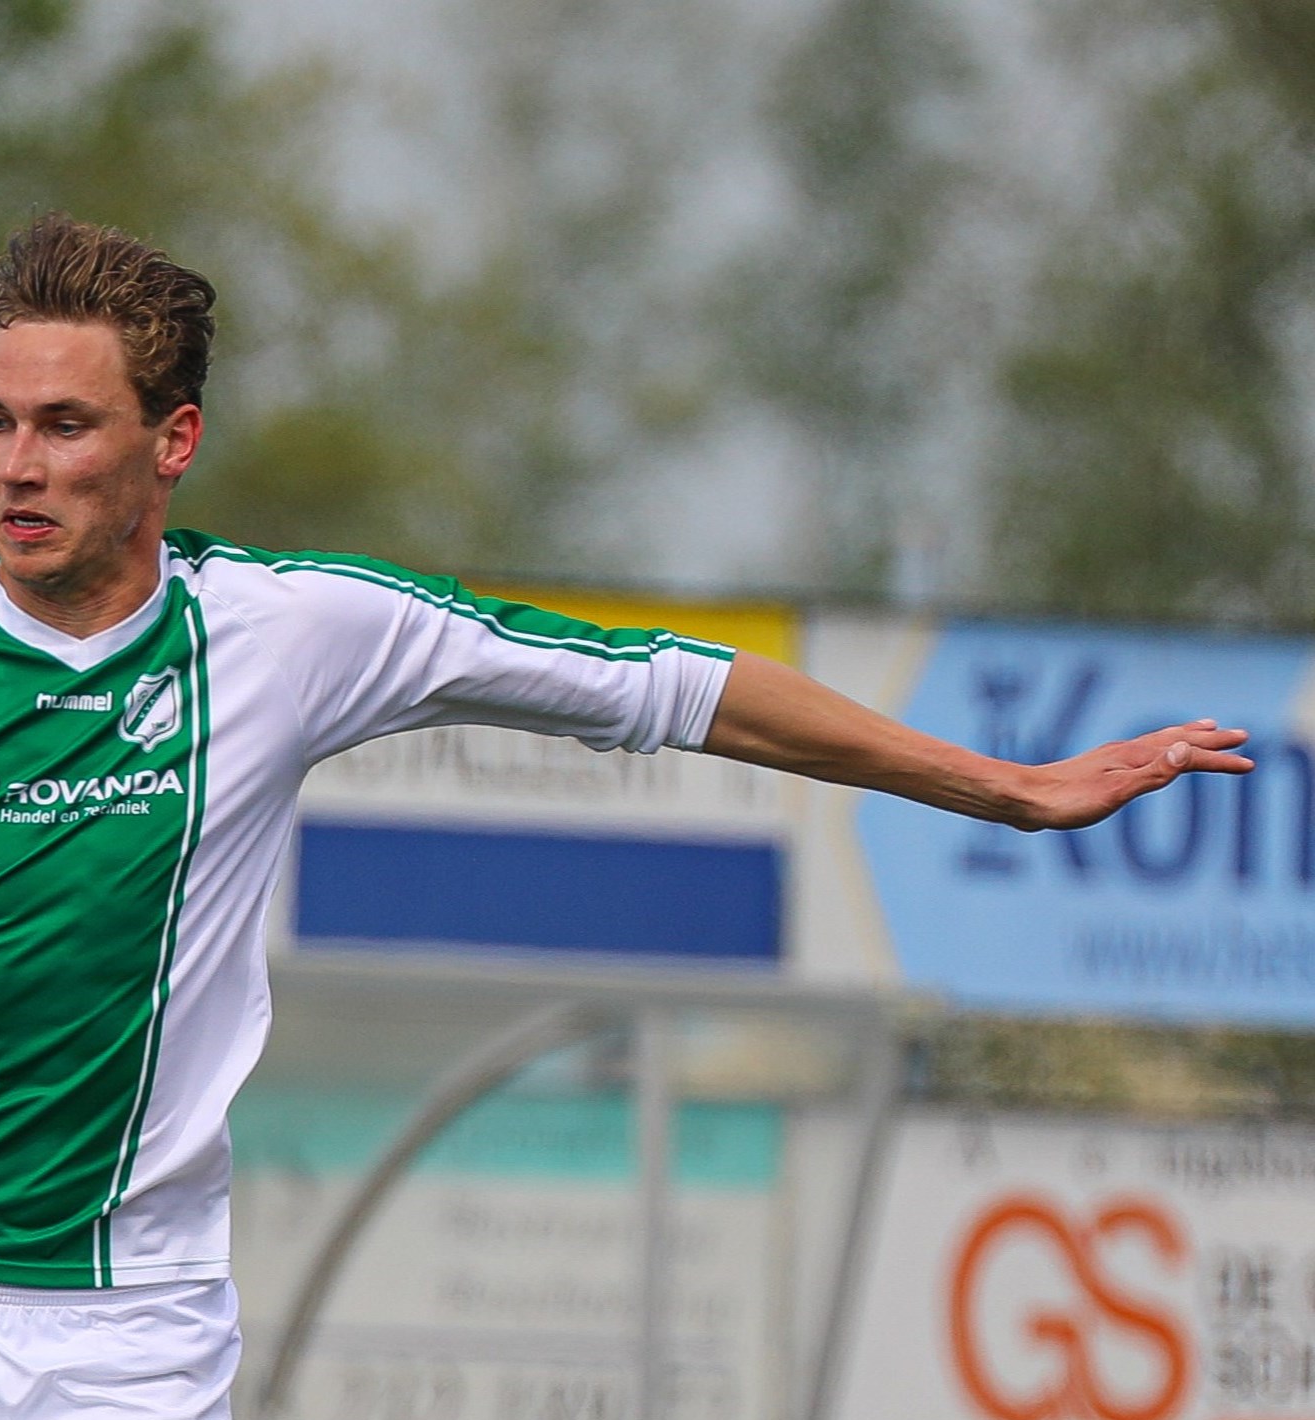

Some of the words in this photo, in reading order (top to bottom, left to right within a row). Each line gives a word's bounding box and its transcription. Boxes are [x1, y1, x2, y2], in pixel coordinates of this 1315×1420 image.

[36, 690, 113, 712] hummel
[4, 769, 185, 805] ROVANDA
[0, 808, 56, 824] Handel
[60, 810, 79, 823] en
